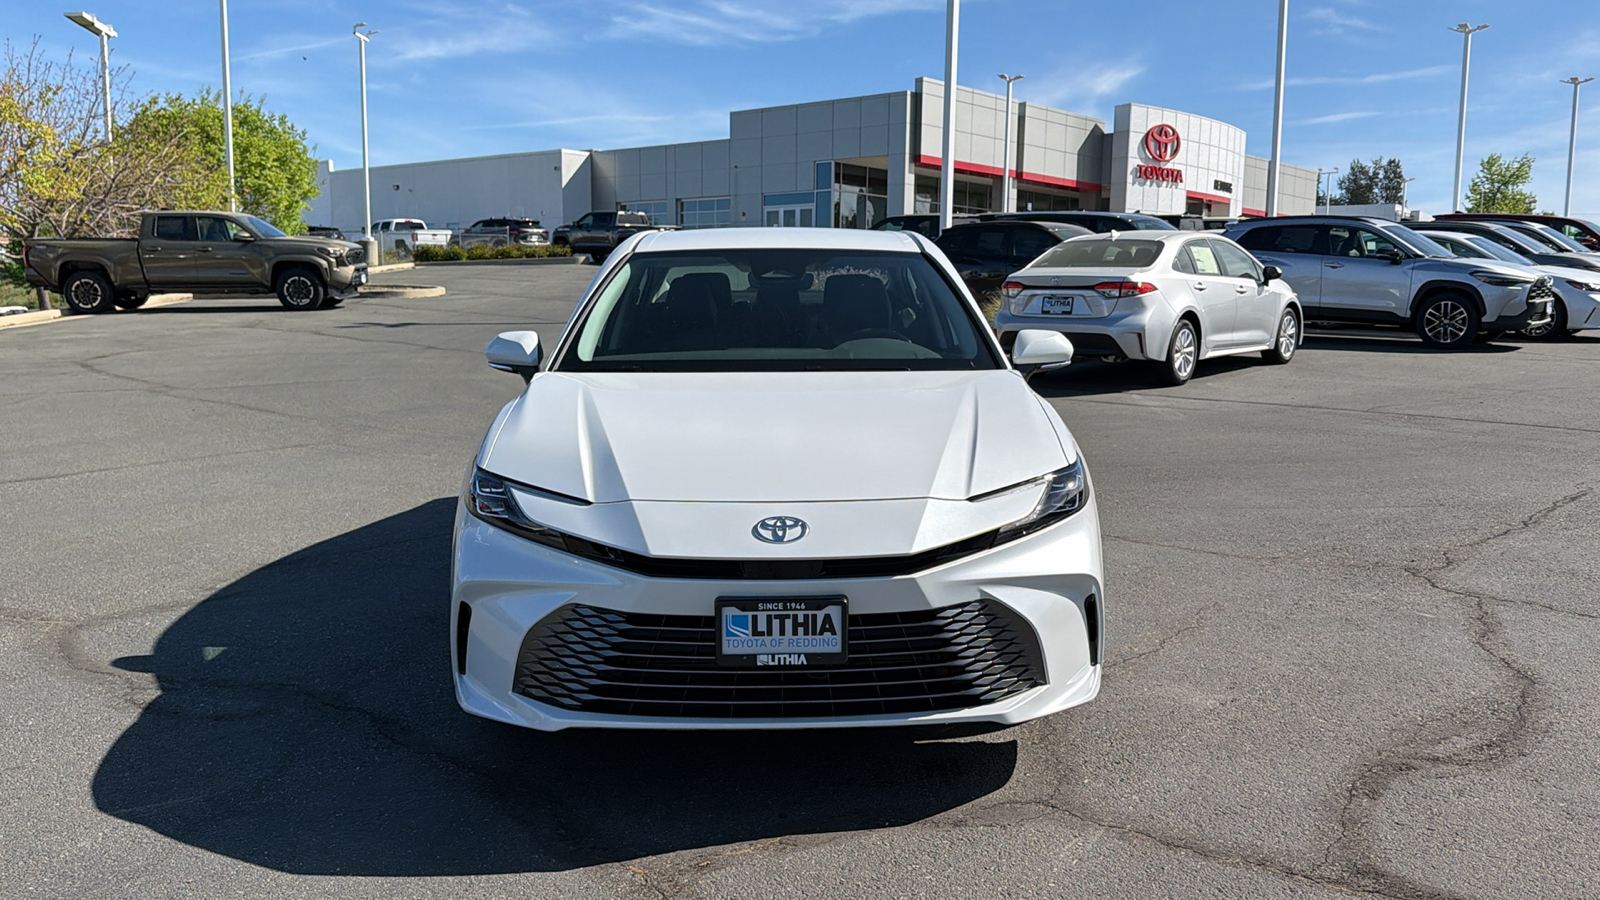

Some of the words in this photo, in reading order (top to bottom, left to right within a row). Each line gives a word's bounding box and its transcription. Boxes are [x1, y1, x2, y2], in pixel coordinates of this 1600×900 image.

[1137, 164, 1183, 183] TOYOTA
[751, 613, 837, 637] LITHIA
[726, 639, 767, 648] TOYOTA
[770, 638, 784, 648] OF
[787, 637, 838, 648] REDDING
[768, 654, 807, 665] LITHIA
